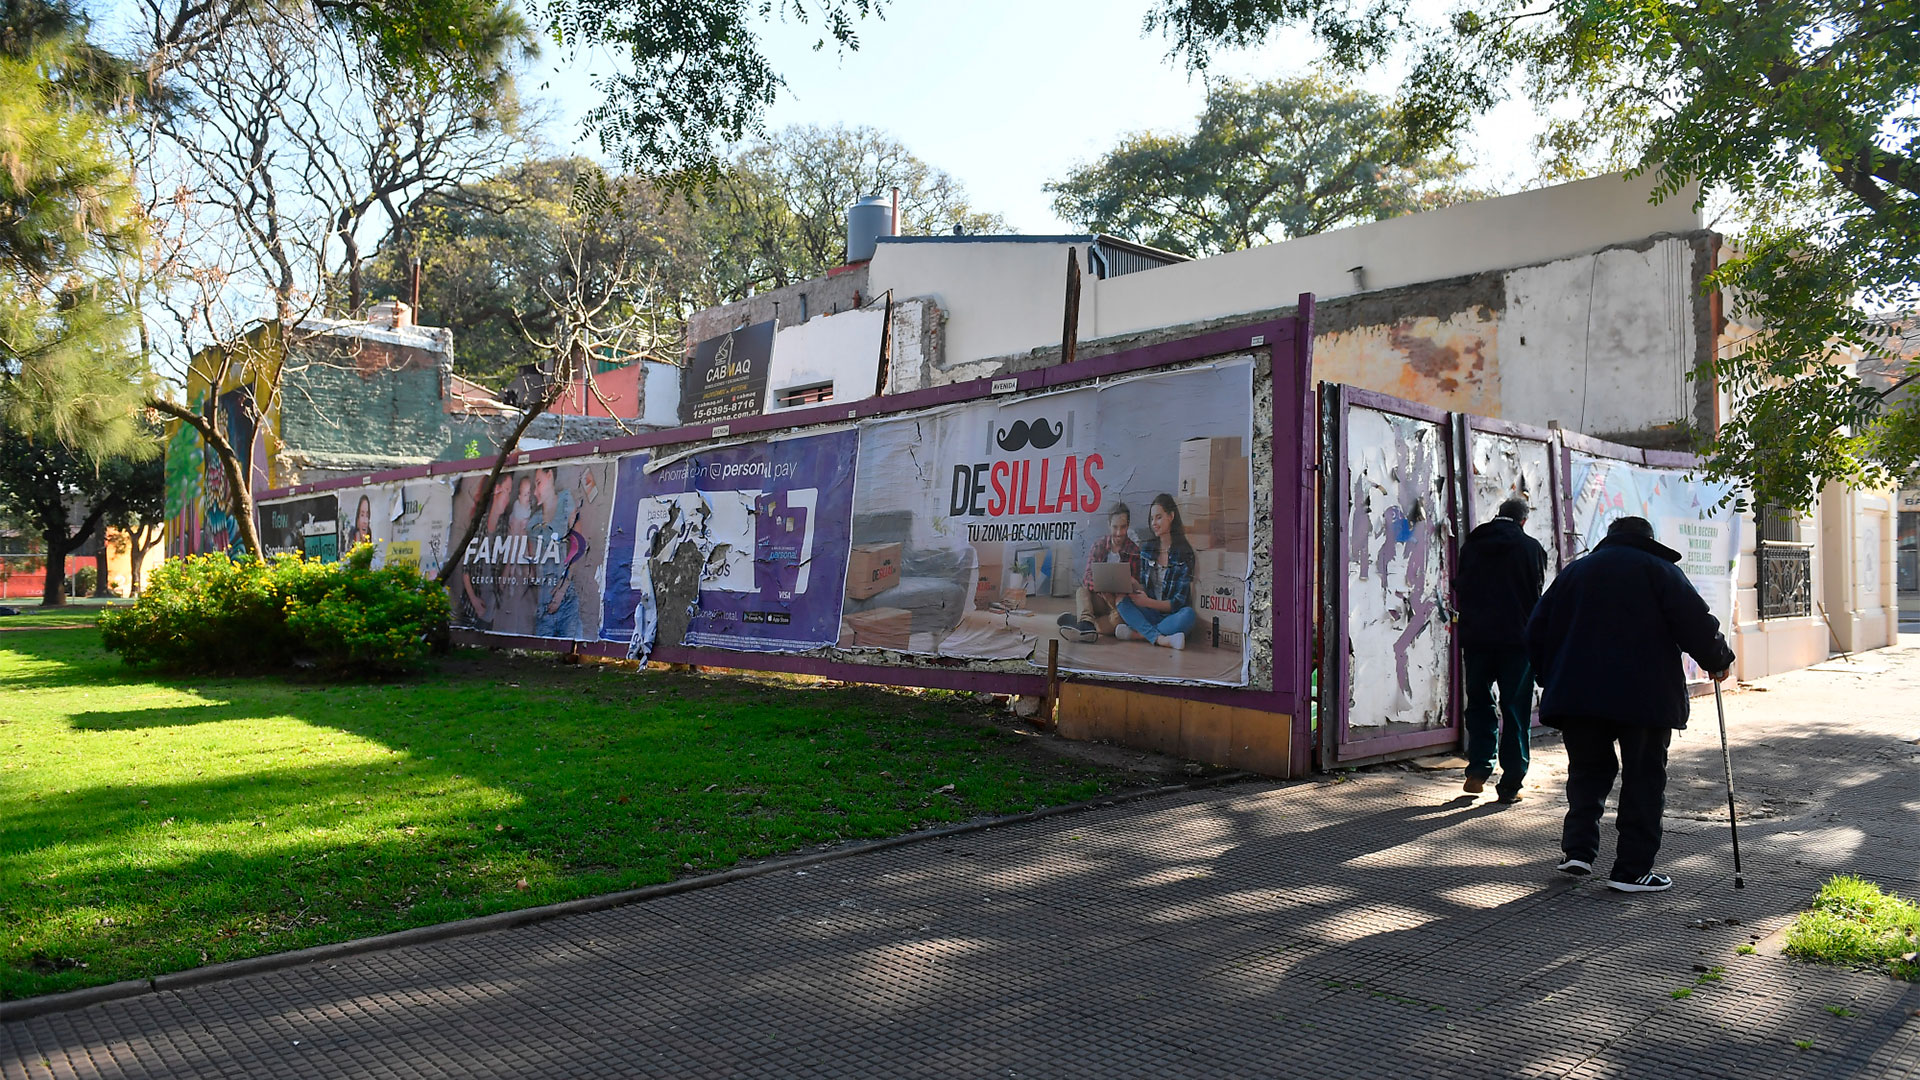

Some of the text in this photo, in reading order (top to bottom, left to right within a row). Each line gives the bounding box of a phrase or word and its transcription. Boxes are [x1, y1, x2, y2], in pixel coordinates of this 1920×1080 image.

[706, 359, 751, 382] CABMAQ
[994, 382, 1016, 390] AVENIDA
[693, 399, 755, 419] 15-6395-8716
[773, 462, 798, 481] pay
[950, 453, 1104, 517] DESILLAS
[968, 522, 1076, 542] TU ZONA DE CONFORT
[463, 534, 560, 565] FAMILIA
[471, 576, 493, 584] CERCA
[523, 577, 557, 586] SIEMPRE
[779, 591, 791, 600] VISA
